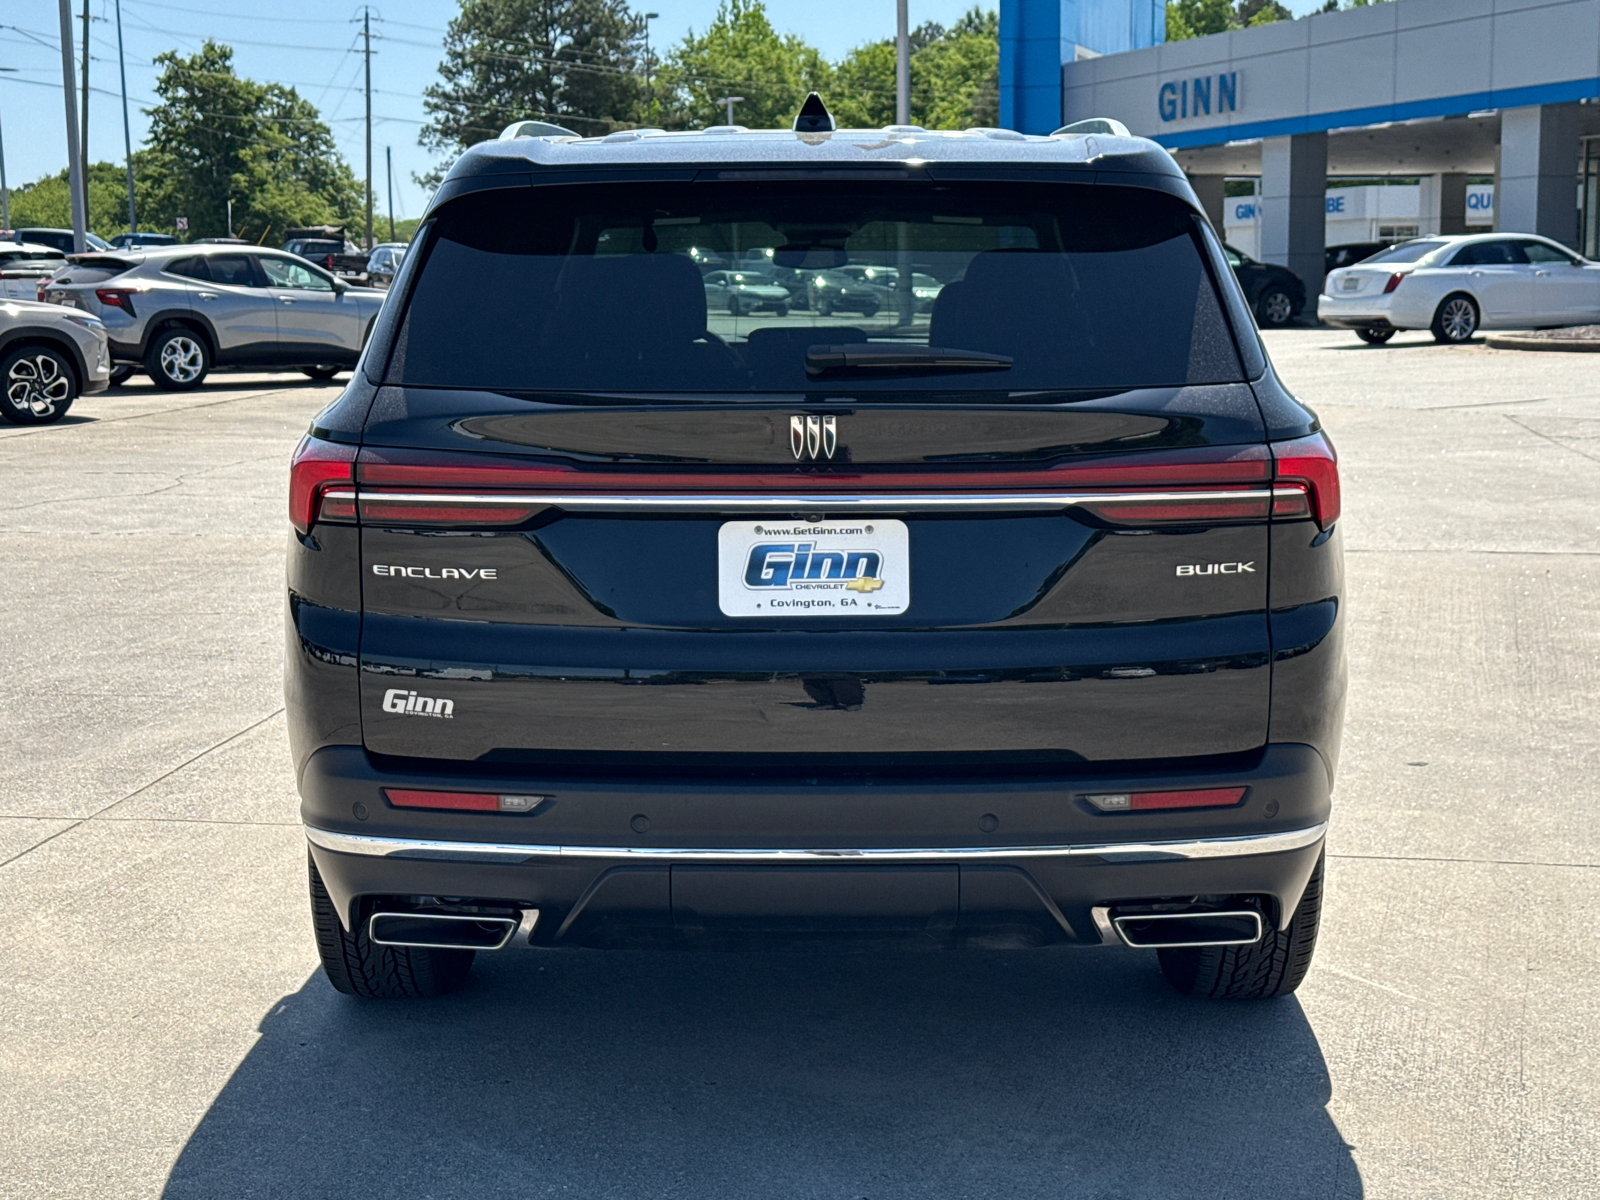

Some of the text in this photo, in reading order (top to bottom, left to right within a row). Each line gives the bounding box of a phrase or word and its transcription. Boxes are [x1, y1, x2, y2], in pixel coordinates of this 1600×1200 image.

[1158, 71, 1238, 122] GINN
[1467, 193, 1494, 211] QU
[764, 526, 863, 536] www.GetGinn.com
[372, 564, 498, 580] ENCLAVE
[744, 543, 881, 587] Ginn
[1175, 561, 1256, 577] BUICK
[770, 598, 858, 609] Covington, GA
[382, 688, 454, 714] Ginn
